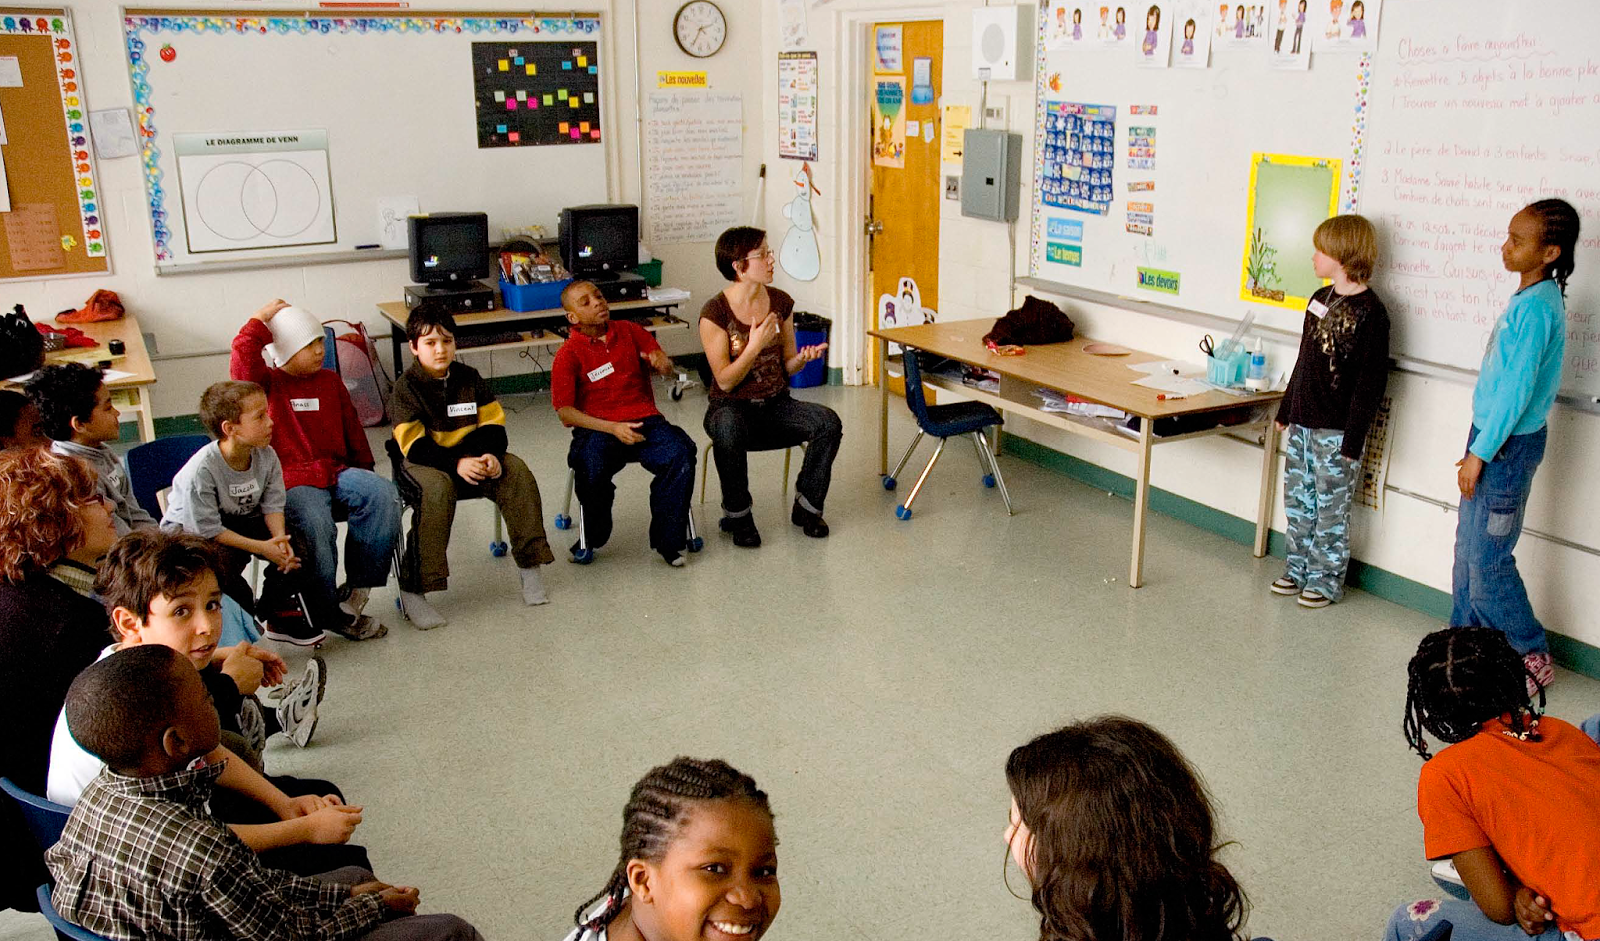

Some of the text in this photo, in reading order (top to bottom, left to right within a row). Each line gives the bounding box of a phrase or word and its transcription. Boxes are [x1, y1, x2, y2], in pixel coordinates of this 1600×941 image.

[1397, 38, 1437, 59] Choses
[1522, 62, 1535, 80] la
[1539, 59, 1573, 80] bonne
[665, 74, 706, 85] Les nouvelles
[1443, 98, 1458, 110] un
[1509, 91, 1530, 108] mot
[206, 139, 216, 147] LE
[217, 137, 264, 146] DIAGRAMME
[1395, 140, 1407, 154] Le
[1438, 142, 1449, 156] de
[1394, 167, 1431, 187] Madame
[1516, 183, 1534, 195] une
[1539, 177, 1569, 198] ferme
[1431, 192, 1442, 206] de
[1391, 213, 1403, 228] Tu
[1054, 246, 1061, 260] Le
[1144, 271, 1178, 291] Les devoirs
[1434, 289, 1456, 306] pas
[1462, 286, 1480, 305] ton
[1472, 313, 1487, 325] de
[449, 405, 475, 413] Vincent
[230, 484, 255, 496] Jacob
